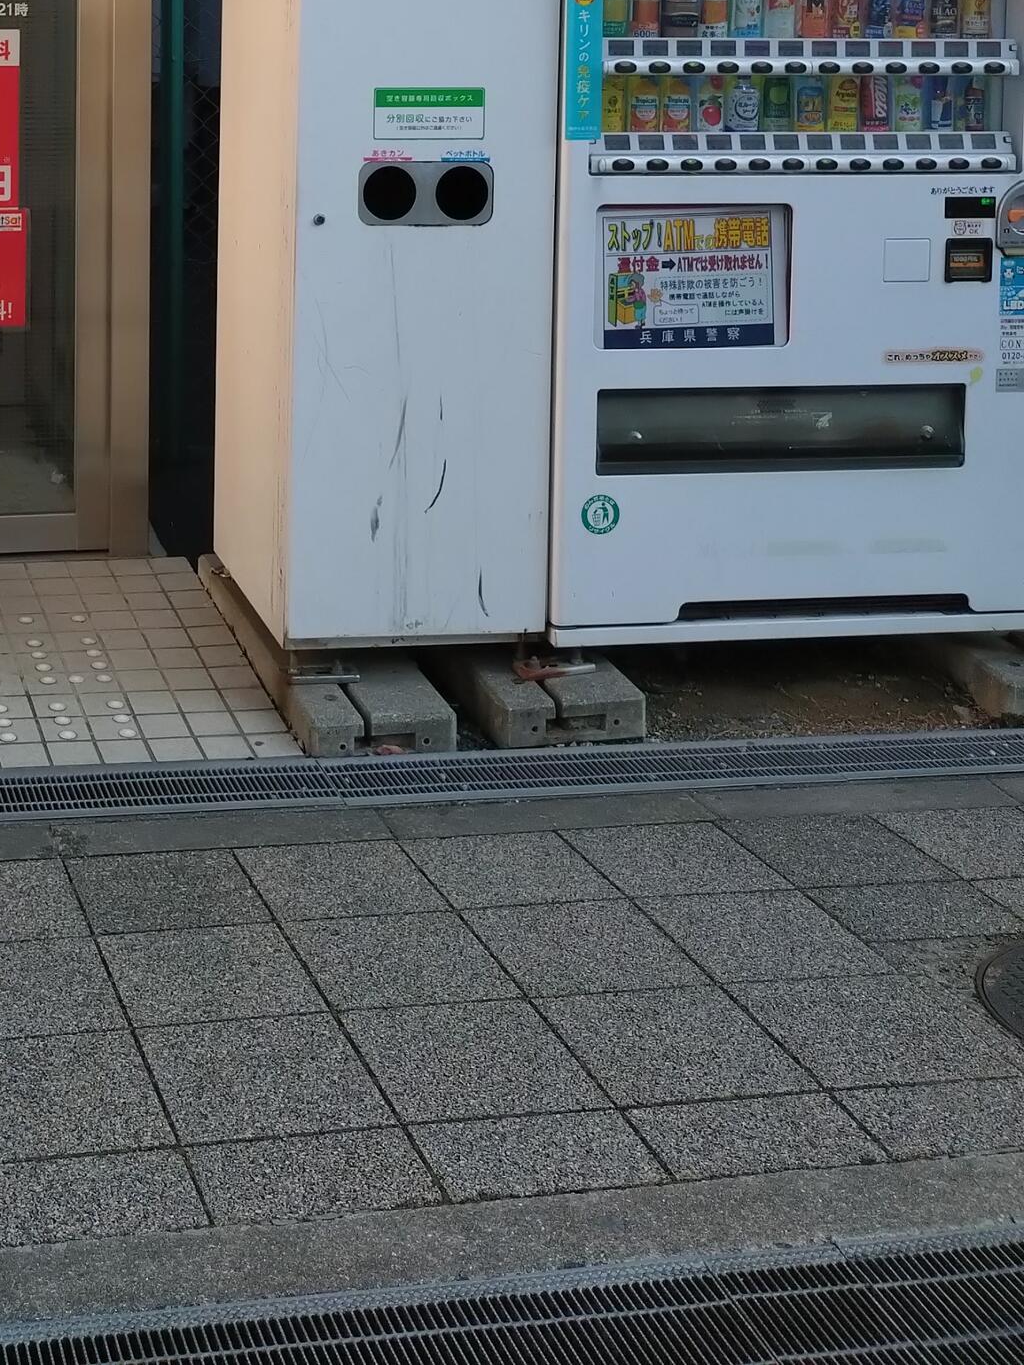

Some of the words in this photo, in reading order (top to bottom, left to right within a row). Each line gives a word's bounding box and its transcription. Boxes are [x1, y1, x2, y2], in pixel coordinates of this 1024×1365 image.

[446, 149, 486, 157] ペットボトル
[930, 186, 995, 194] ありがとうございます
[640, 327, 740, 344] 兵庫県警察
